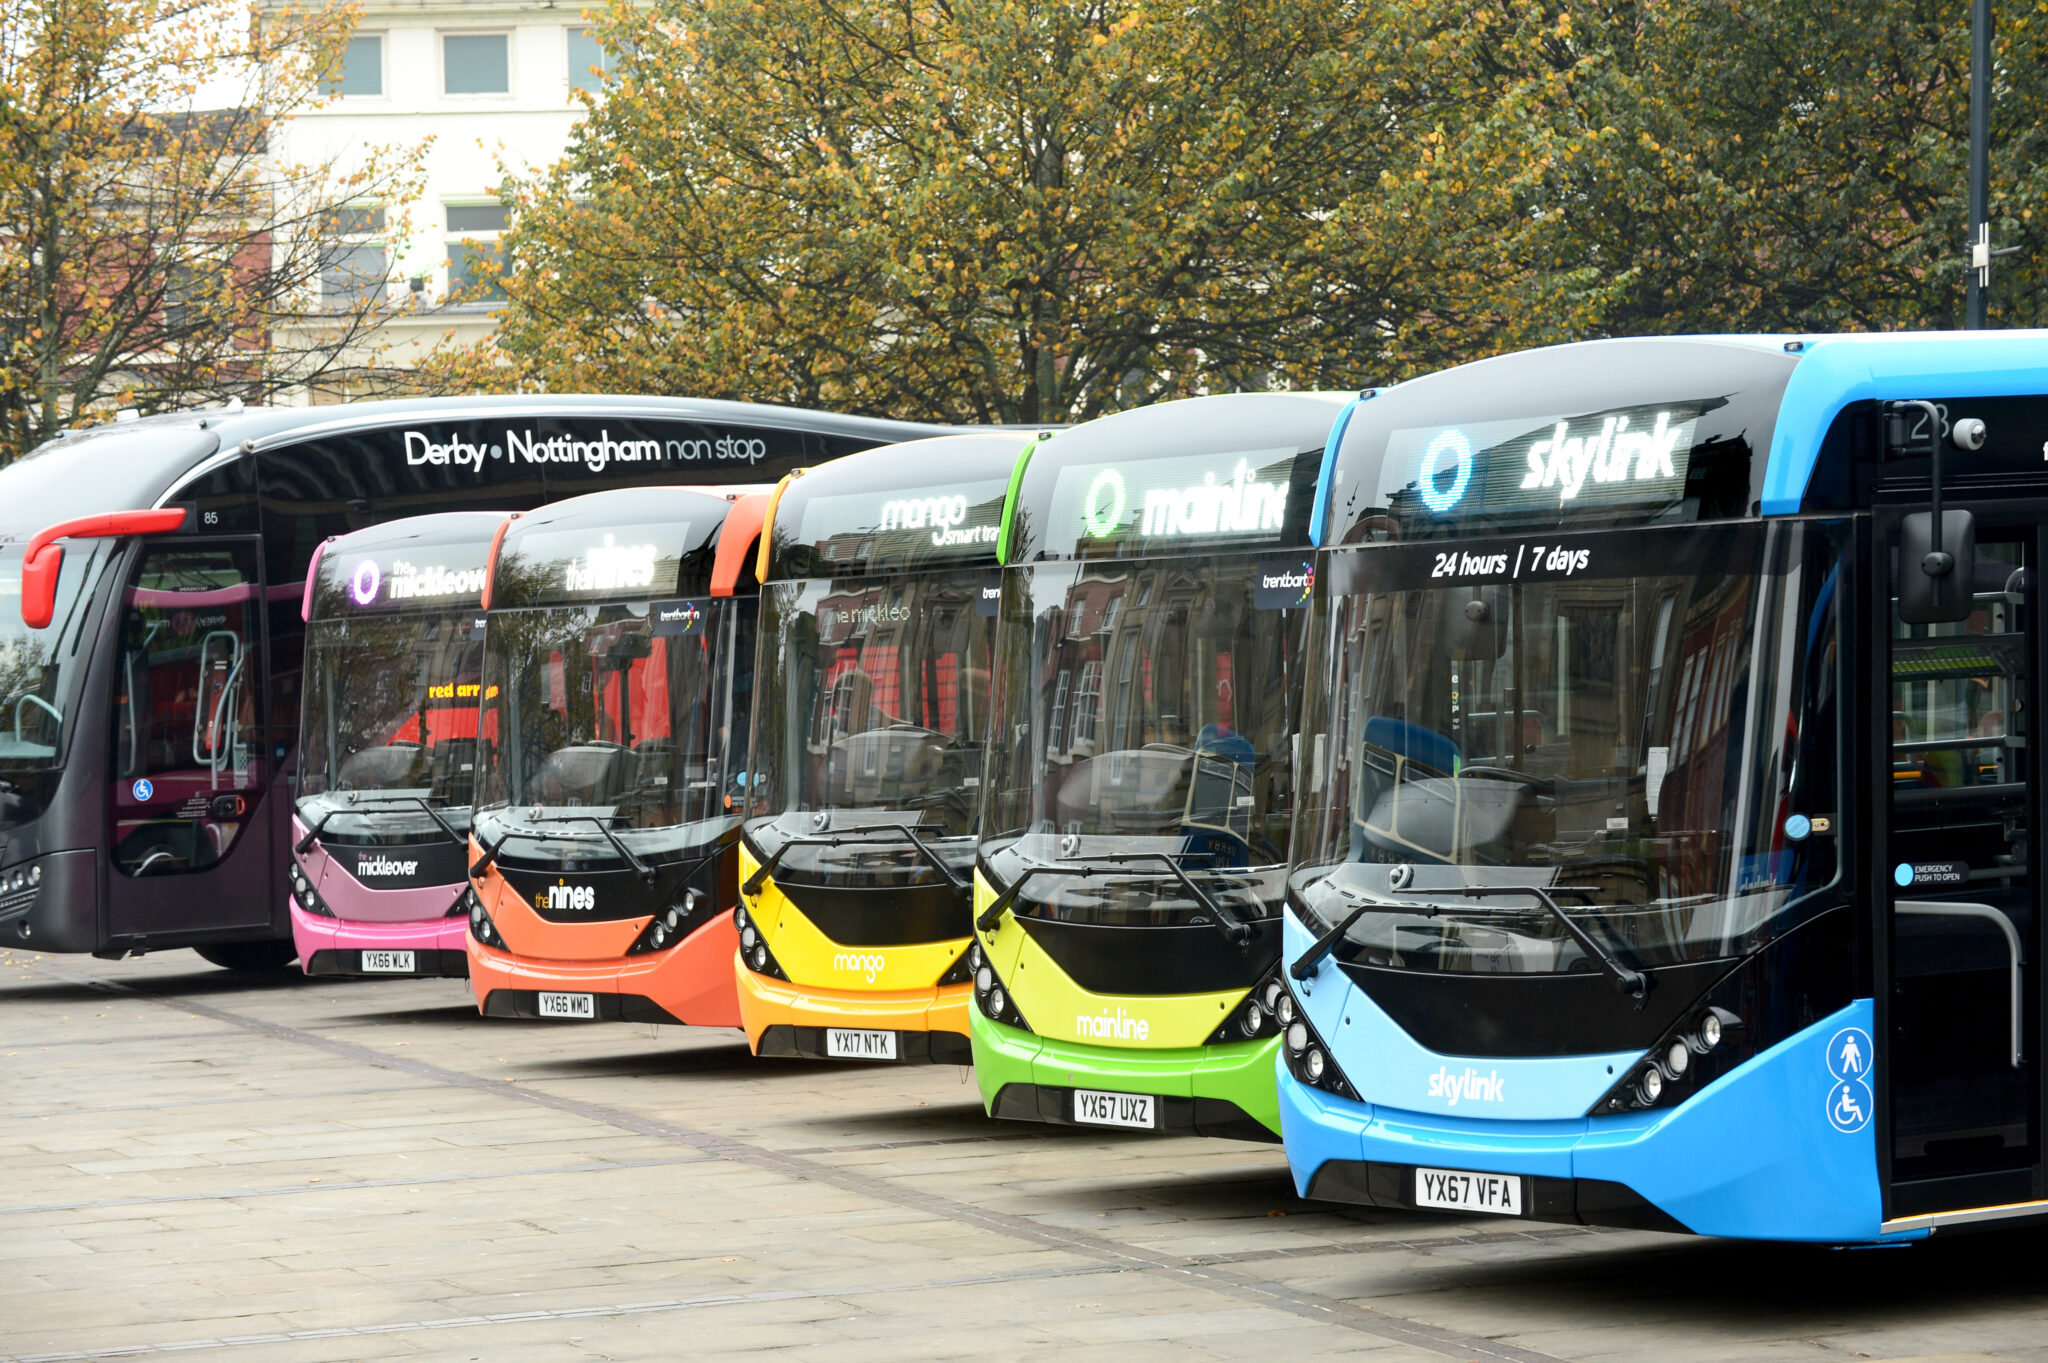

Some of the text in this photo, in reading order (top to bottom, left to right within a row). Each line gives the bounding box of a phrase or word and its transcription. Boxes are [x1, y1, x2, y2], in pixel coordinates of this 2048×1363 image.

[404, 429, 766, 473] Derby Nottingham non stop
[1520, 411, 1682, 500] skylink
[204, 511, 219, 524] 85
[881, 495, 967, 546] mango
[945, 527, 980, 545] smart
[1431, 553, 1456, 578] 24
[1458, 550, 1507, 576] hours
[1530, 546, 1546, 572] 7
[1545, 545, 1590, 575] days
[1263, 571, 1315, 590] trentbarto
[429, 682, 455, 699] red
[456, 684, 481, 698] arr
[358, 854, 418, 876] mickleover
[1914, 864, 1953, 874] EMERGENCY
[1914, 874, 1931, 882] PUSH
[1942, 873, 1960, 881] OPEN
[366, 953, 410, 968] YX66 WLK
[833, 954, 885, 984] mango
[543, 995, 589, 1014] YX66 WMD
[1076, 1006, 1149, 1040] mainline
[834, 1032, 888, 1054] YX17 NTK
[1427, 1066, 1505, 1106] skylink
[1080, 1094, 1148, 1123] YX67 UXZ
[1424, 1173, 1512, 1208] YX67 VFA
